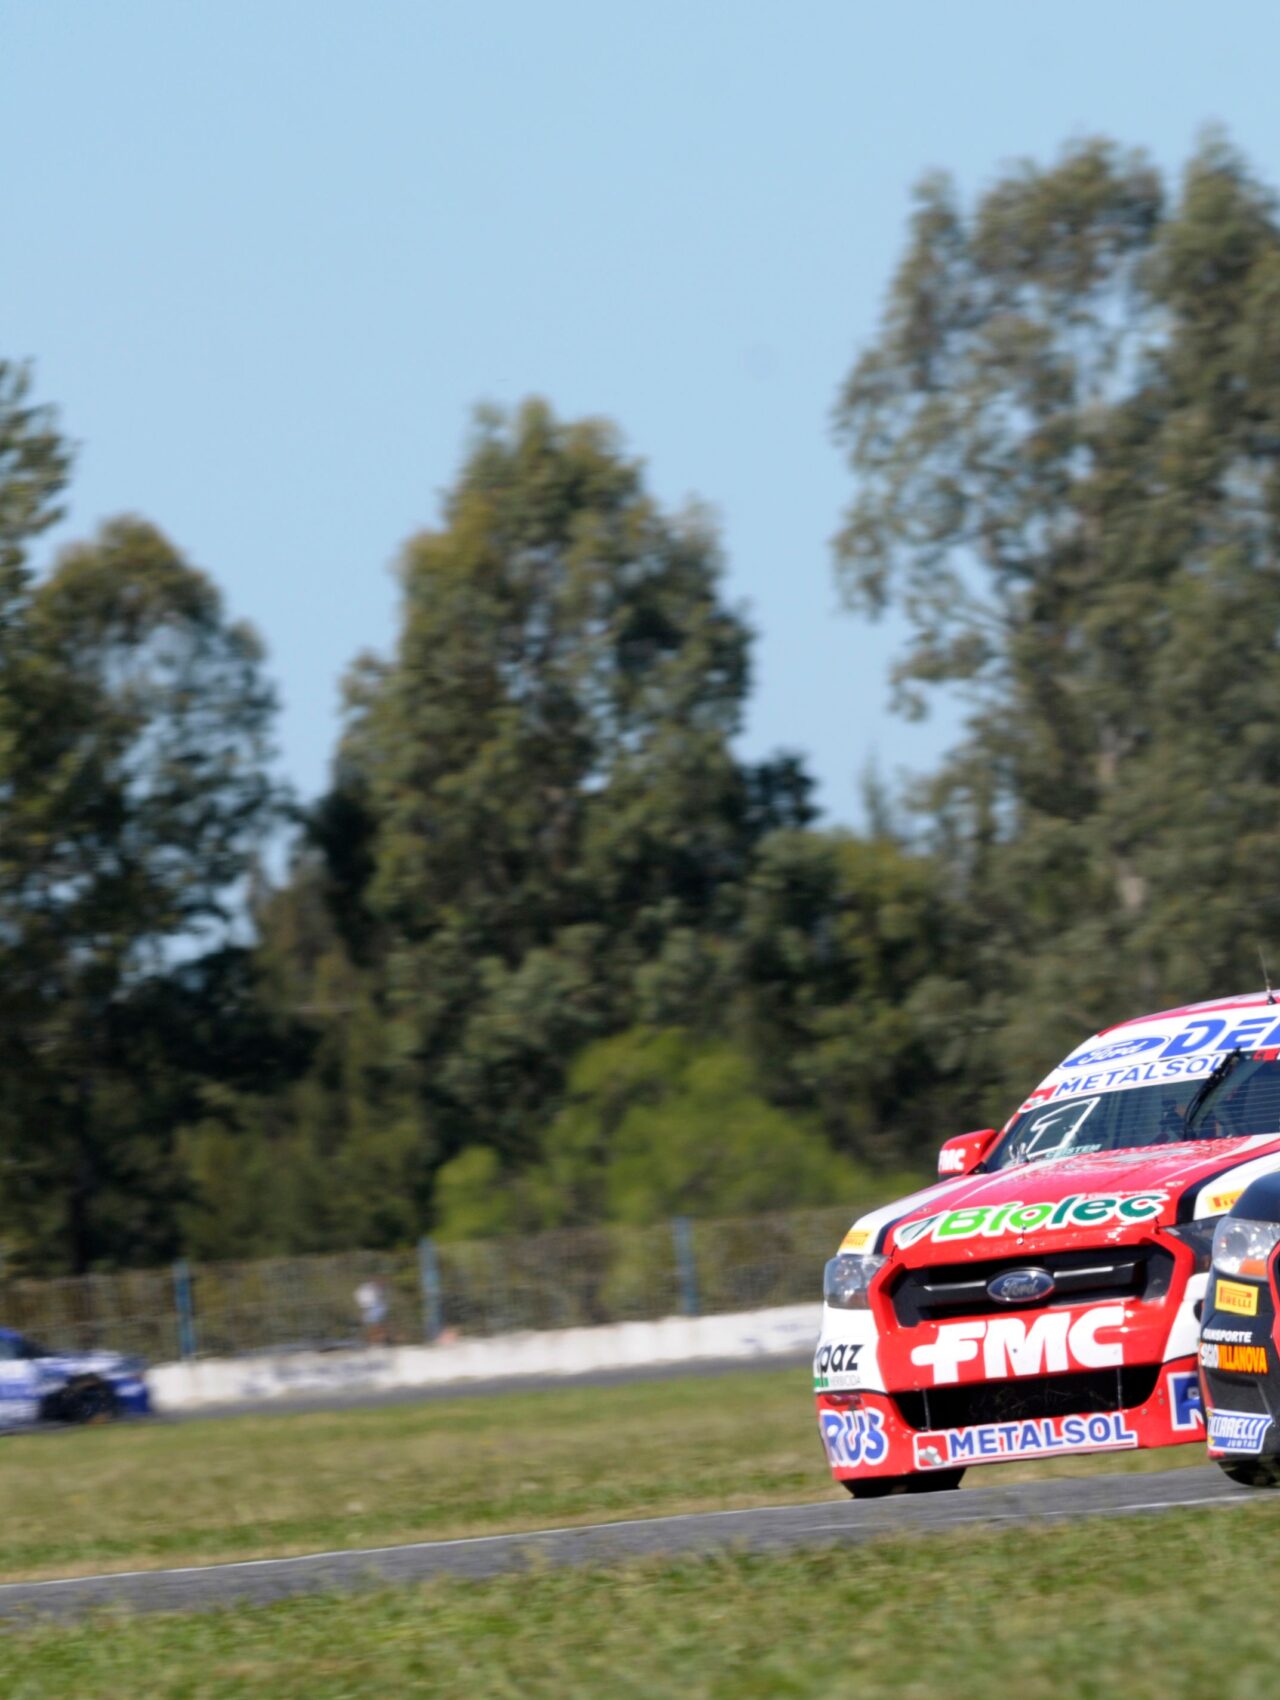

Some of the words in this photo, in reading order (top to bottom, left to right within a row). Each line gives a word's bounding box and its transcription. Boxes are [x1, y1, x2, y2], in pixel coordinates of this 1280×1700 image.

[1055, 1057, 1220, 1097] METALSOL
[934, 1193, 1169, 1239] Biolec
[1218, 1285, 1253, 1309] PIRELLI
[911, 1305, 1124, 1386] FMC
[820, 1408, 888, 1466] RUS
[950, 1414, 1134, 1458] METALSOL
